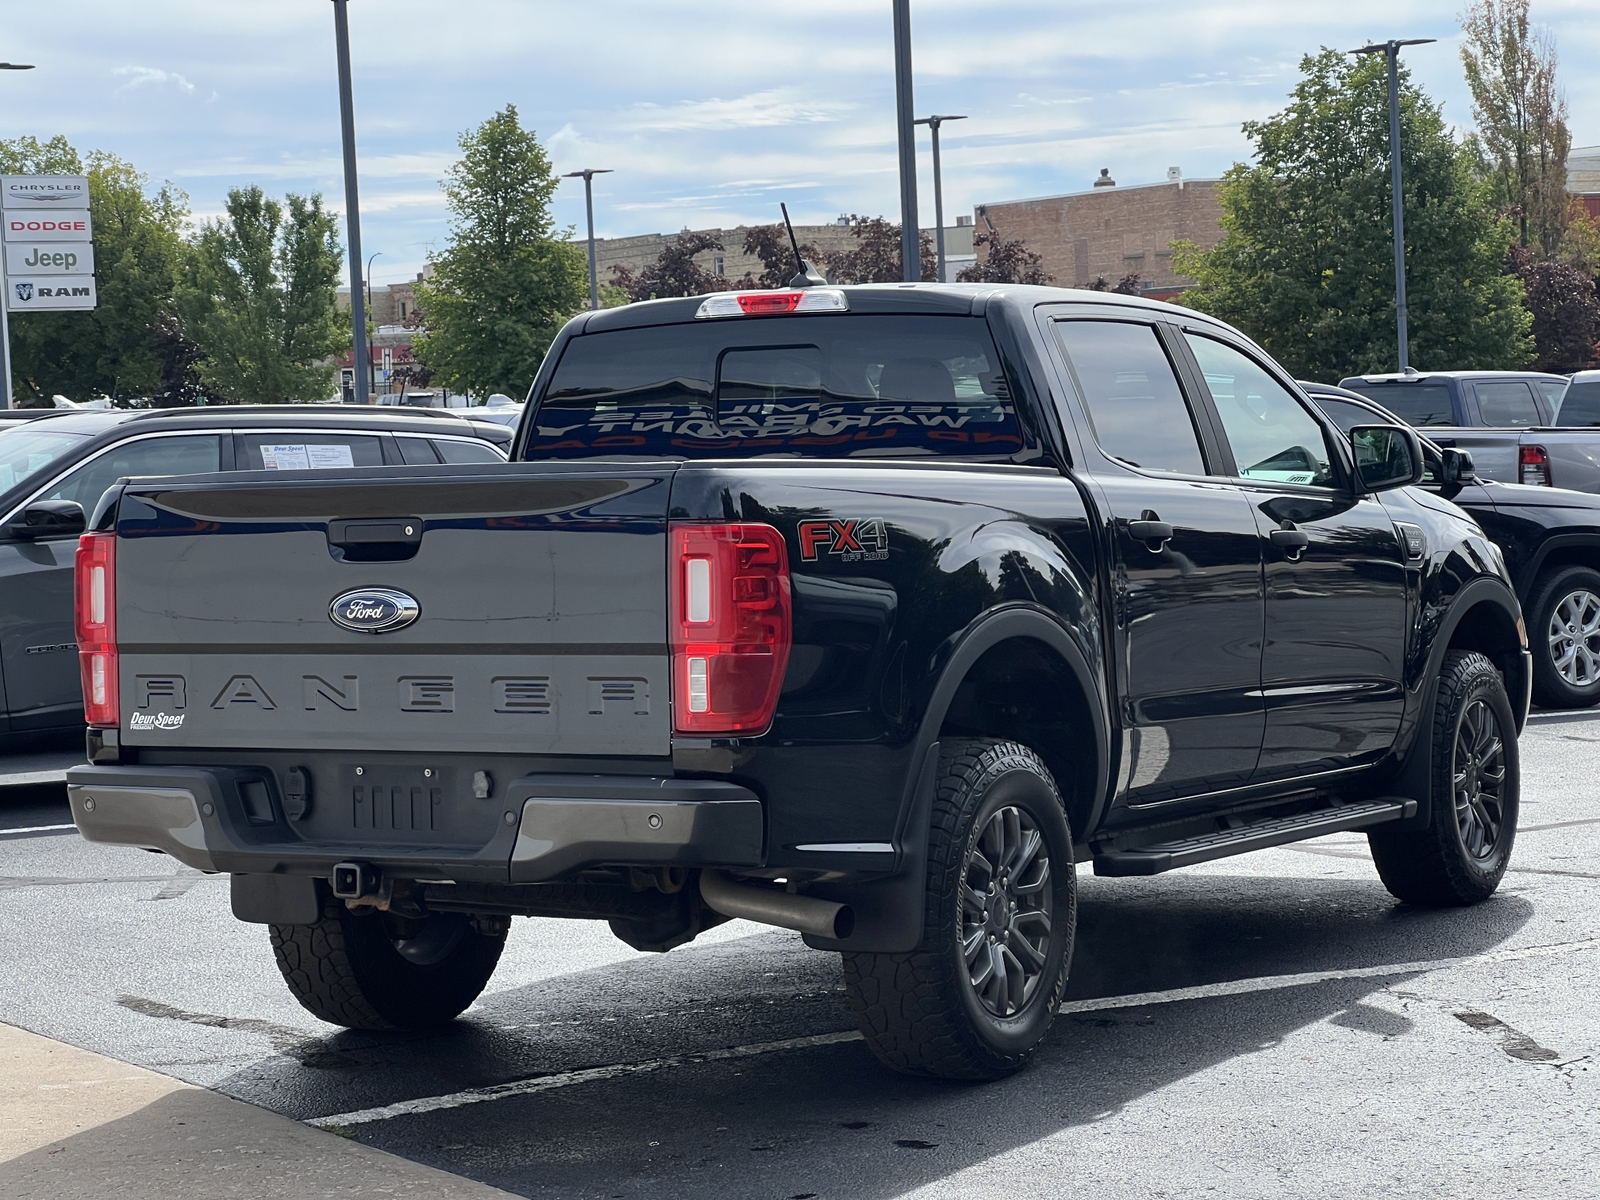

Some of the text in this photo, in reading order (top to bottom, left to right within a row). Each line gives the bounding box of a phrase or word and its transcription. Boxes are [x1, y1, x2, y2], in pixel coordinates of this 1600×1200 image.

[10, 221, 86, 231] DODGE
[24, 248, 77, 271] Jeep
[38, 287, 90, 297] RAM
[797, 517, 888, 562] FX4
[841, 551, 890, 562] OFF ROAD
[346, 600, 384, 619] Ford
[134, 674, 649, 715] RANGER
[130, 711, 185, 728] Deur Speet
